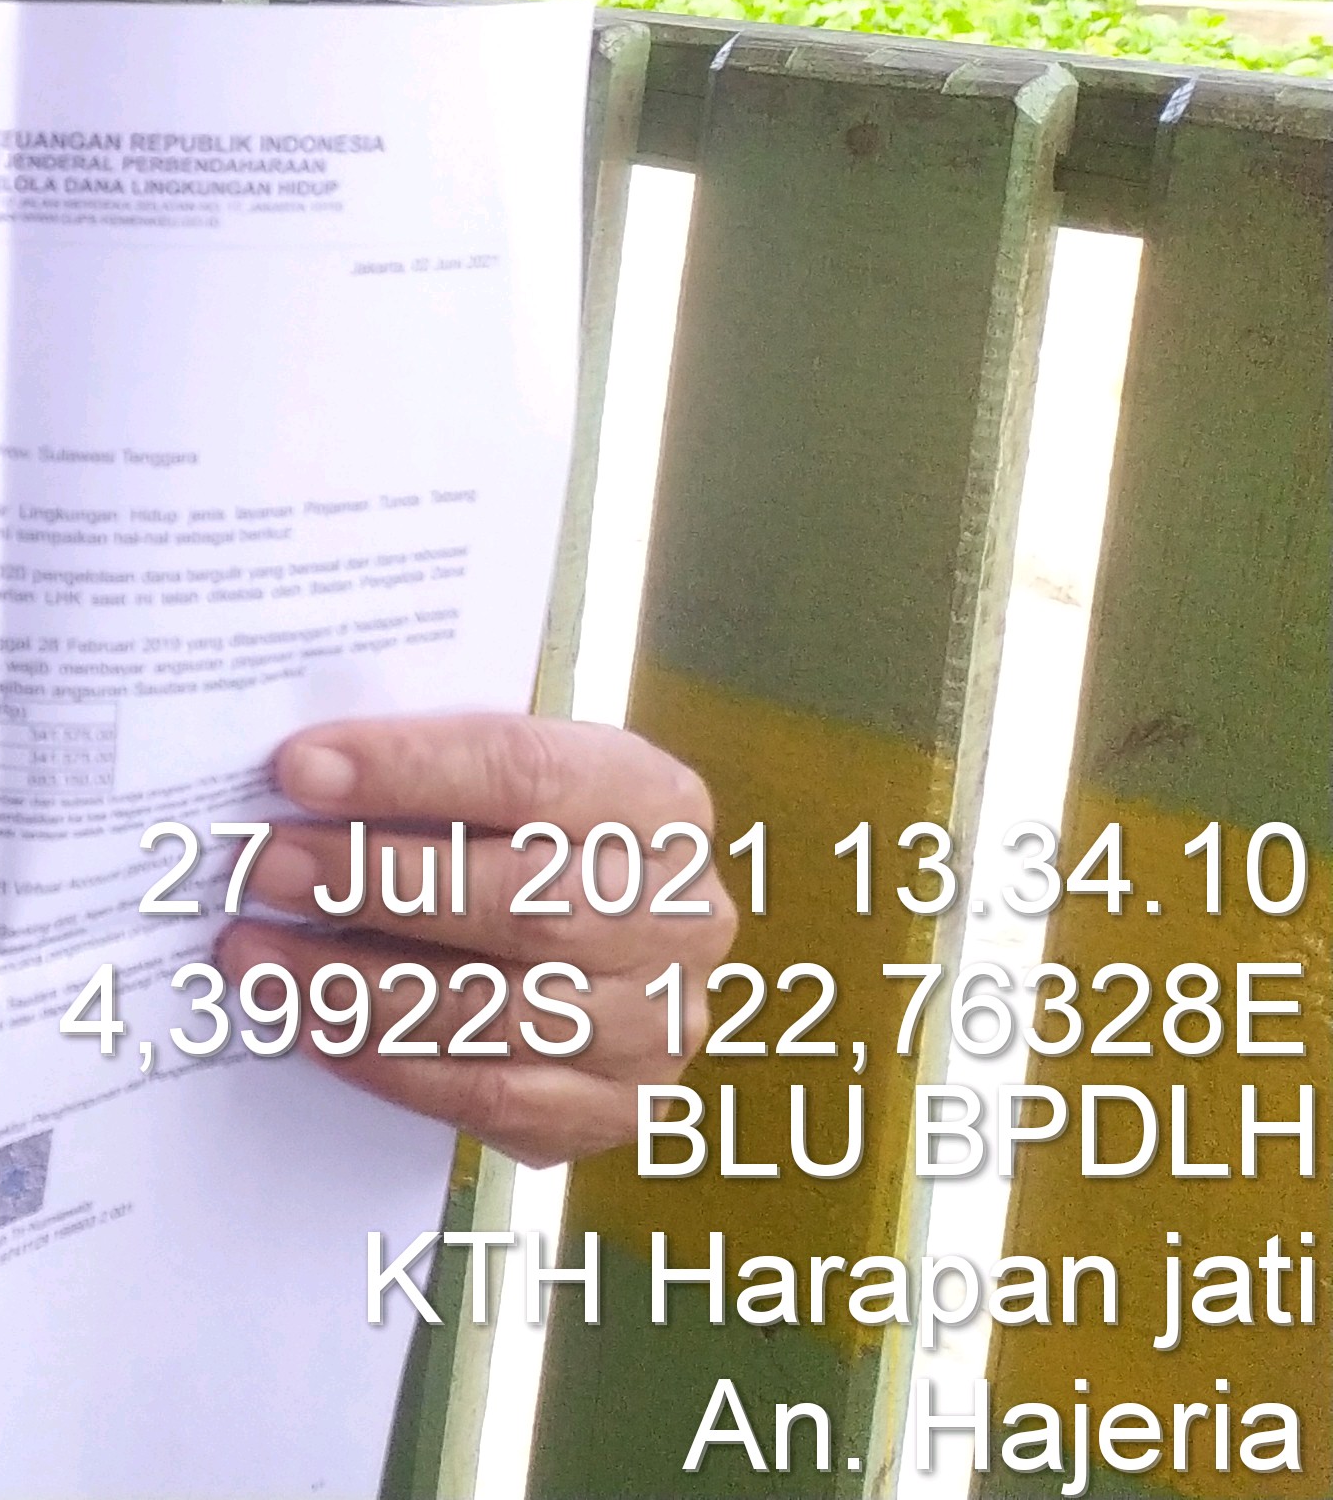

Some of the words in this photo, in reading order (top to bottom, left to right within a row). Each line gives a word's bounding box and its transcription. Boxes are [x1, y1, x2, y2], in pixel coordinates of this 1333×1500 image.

[131, 132, 252, 152] REPUBLIK
[259, 135, 384, 154] INDONESIA
[6, 154, 113, 172] JENDERAL
[64, 178, 124, 195] DANA
[277, 179, 338, 196] HIDUP
